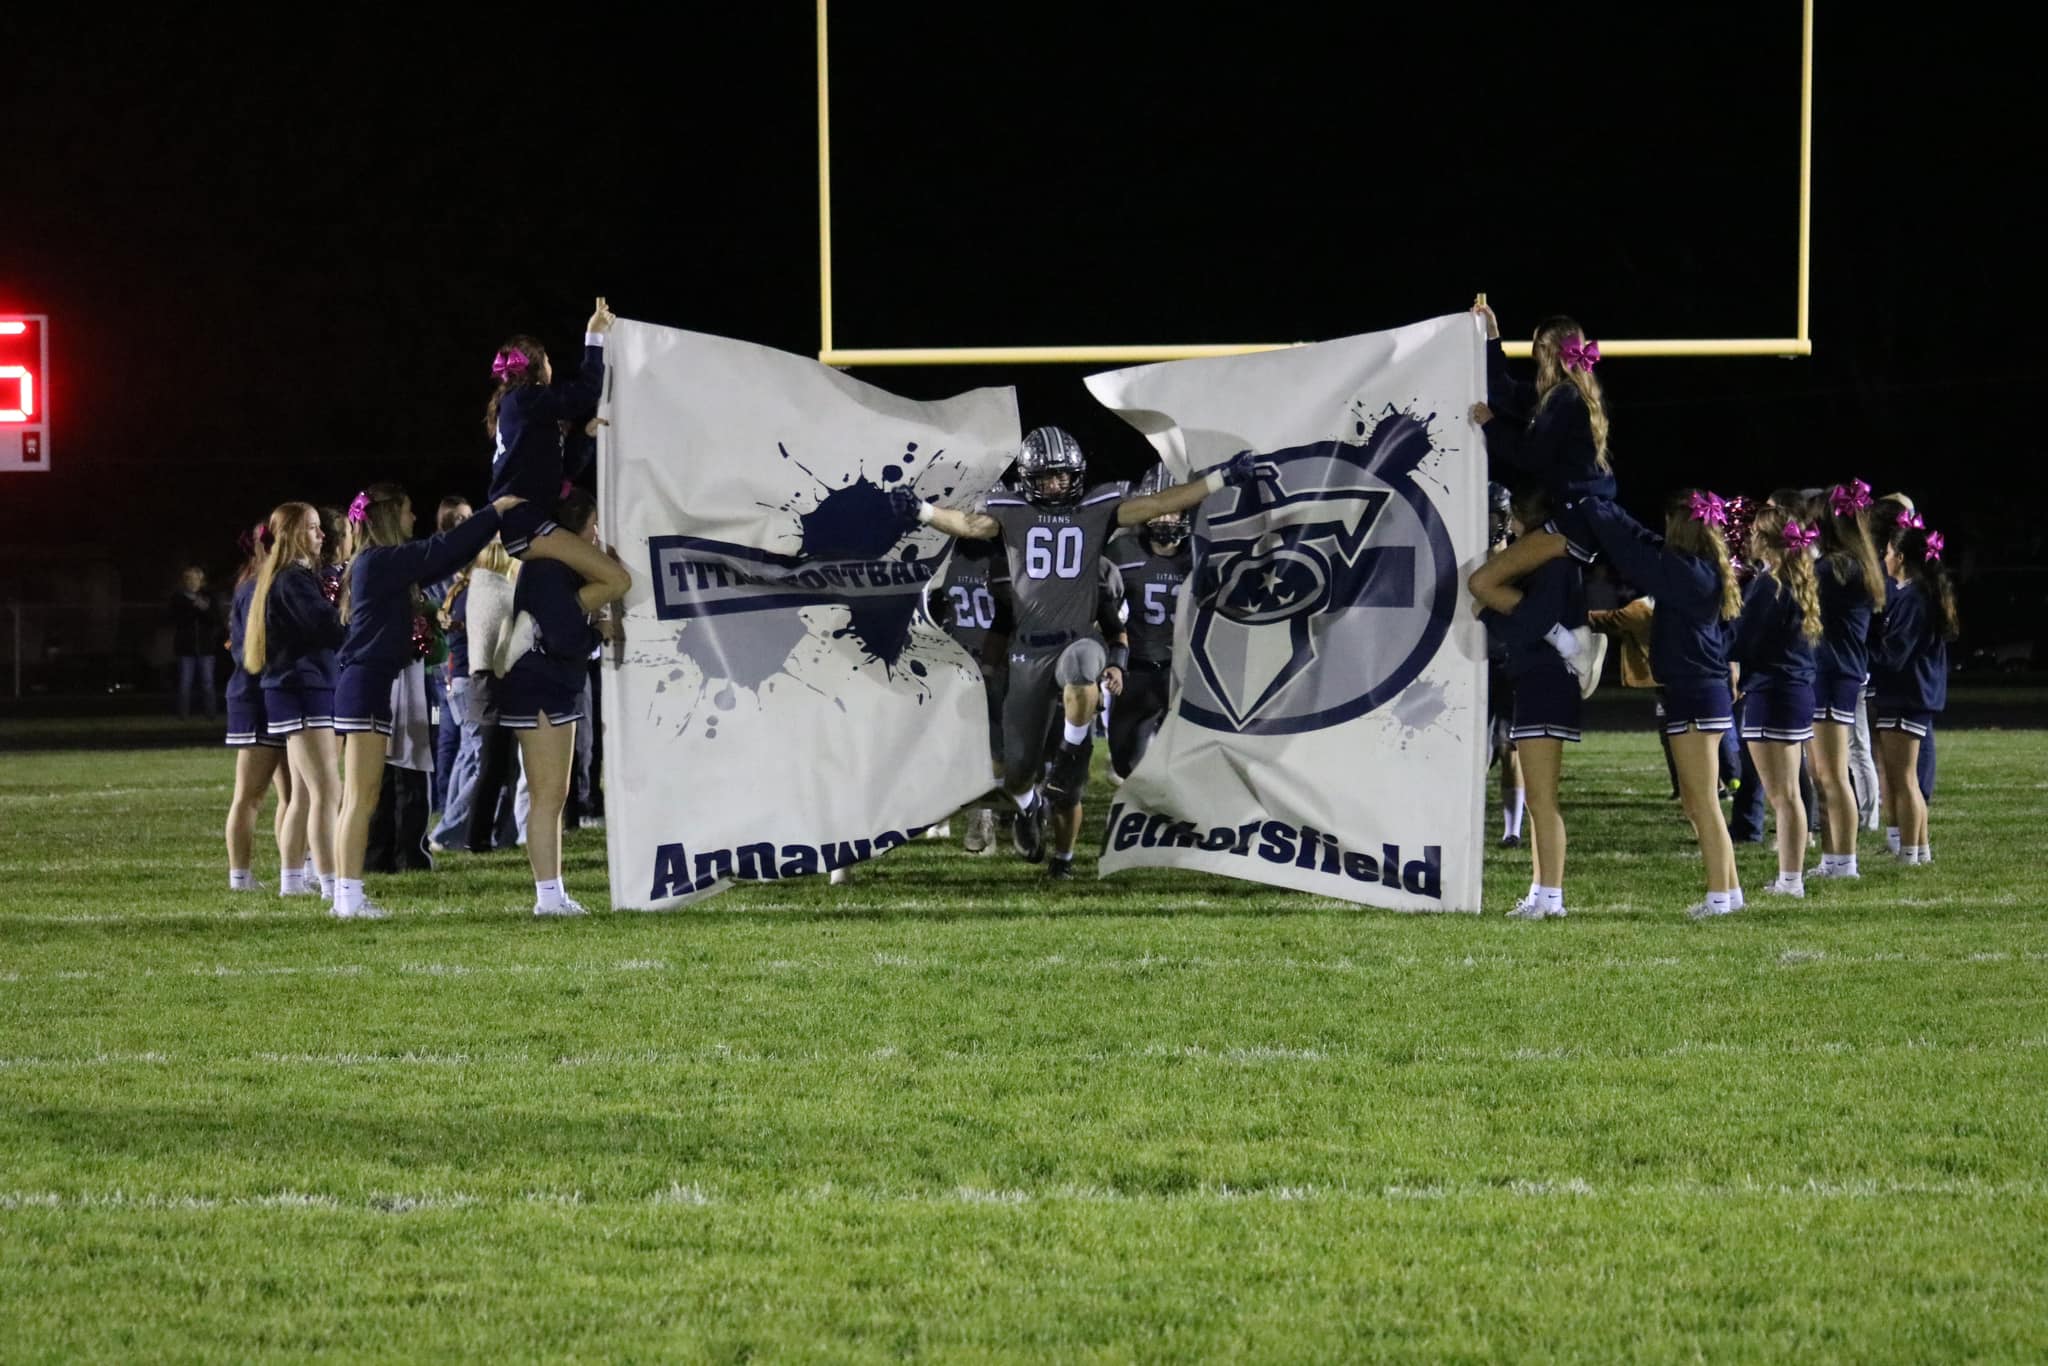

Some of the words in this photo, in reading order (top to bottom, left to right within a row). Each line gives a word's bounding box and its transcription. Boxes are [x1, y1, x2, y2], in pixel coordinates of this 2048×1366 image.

[1038, 514, 1071, 524] TITANS
[1025, 526, 1083, 579] 60
[948, 586, 996, 629] 20
[650, 823, 934, 901] Annawa
